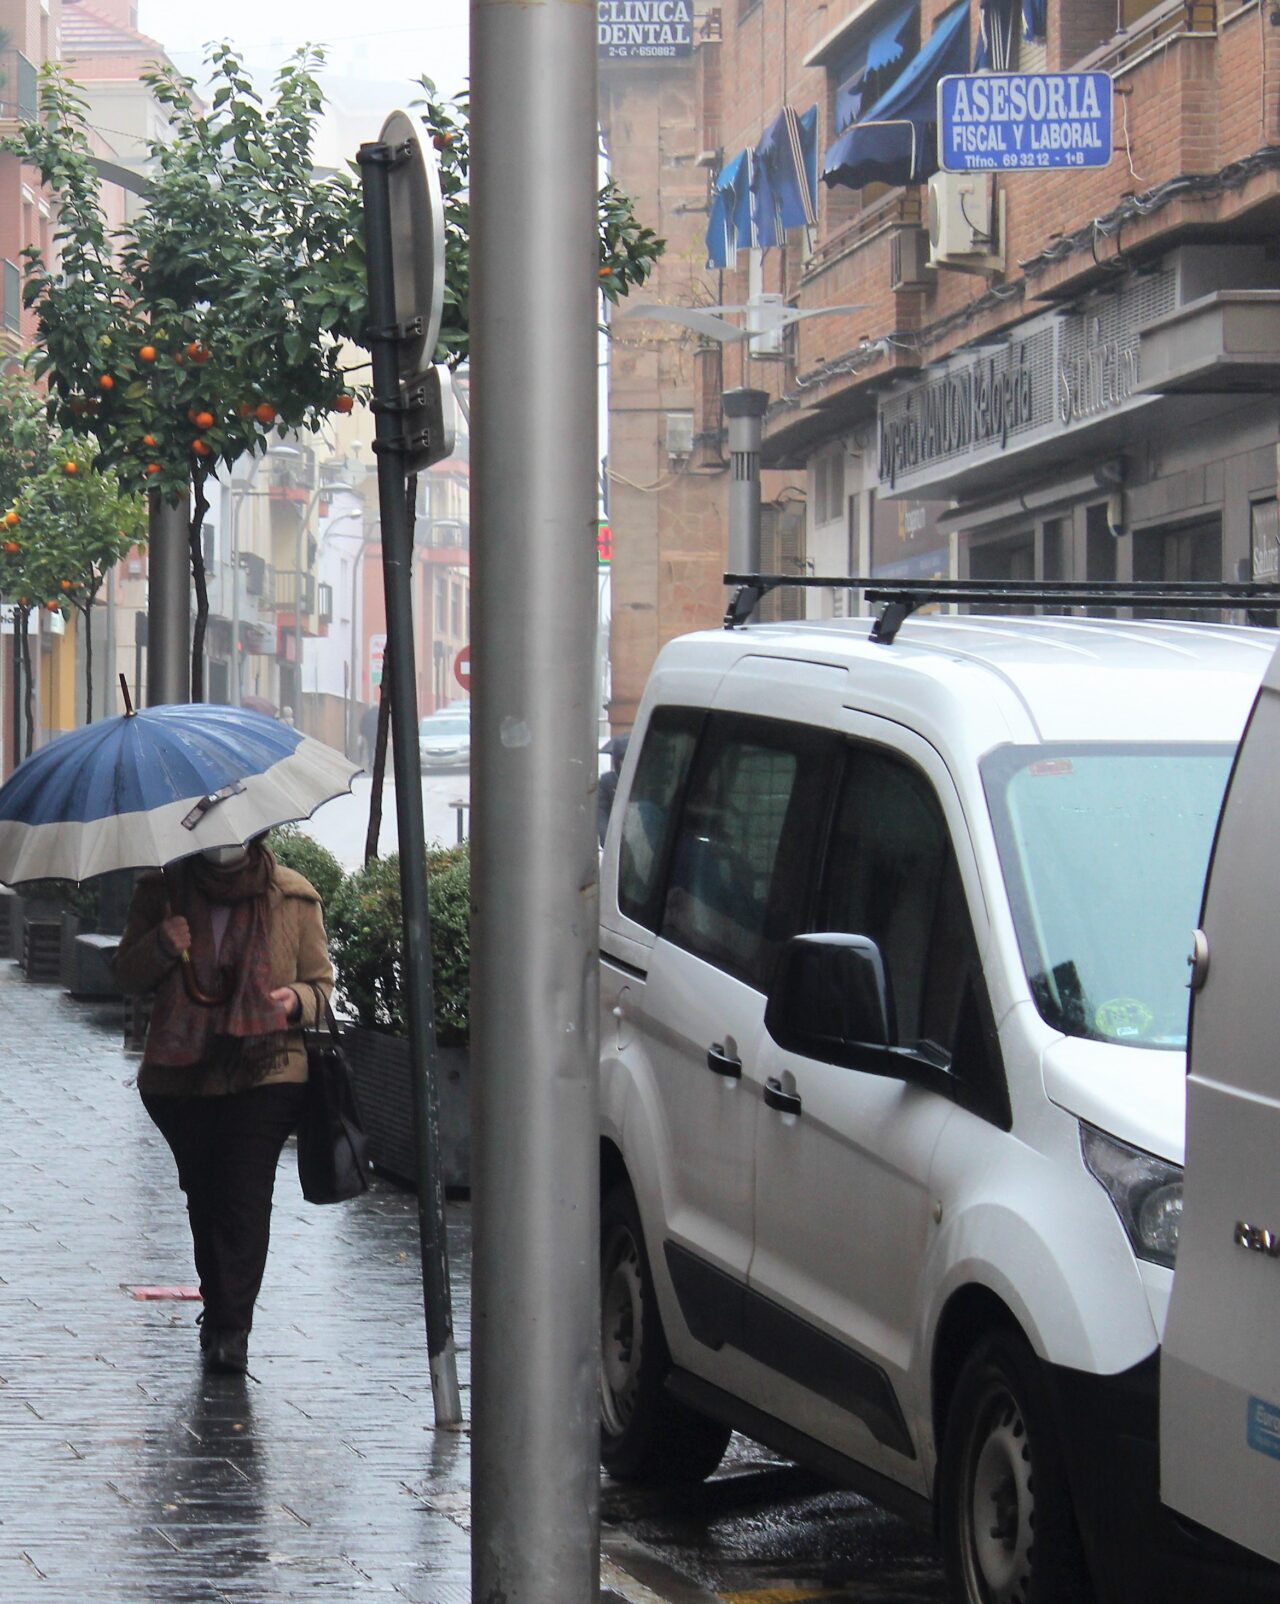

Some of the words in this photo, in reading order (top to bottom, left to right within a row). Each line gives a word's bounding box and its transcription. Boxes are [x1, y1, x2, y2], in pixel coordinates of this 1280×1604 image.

[597, 0, 690, 22] CLINICA
[597, 24, 690, 44] DENTAL
[952, 76, 1102, 123] ASESORIA
[952, 124, 1007, 152] FISCAL
[1013, 123, 1024, 150] Y
[1030, 122, 1102, 150] LABORAL
